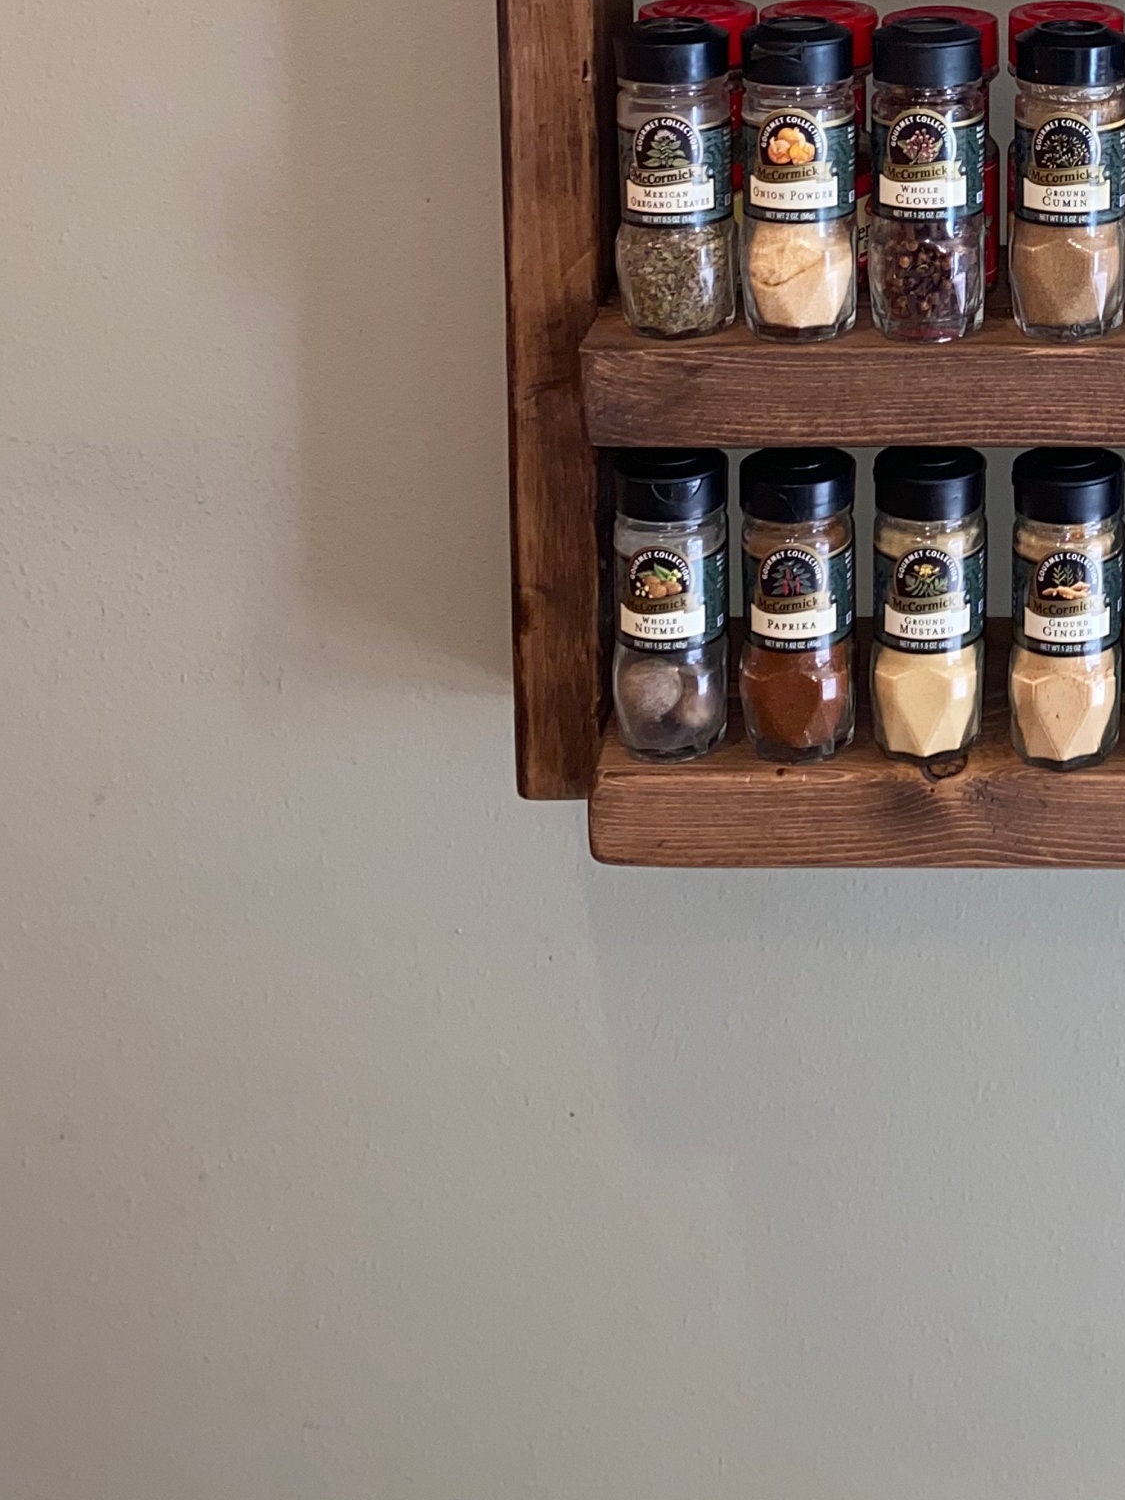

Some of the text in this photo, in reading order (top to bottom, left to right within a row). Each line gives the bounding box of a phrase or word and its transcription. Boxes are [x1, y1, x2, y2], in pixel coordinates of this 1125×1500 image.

[636, 119, 698, 151] GOURMET COLLECTION
[761, 115, 822, 148] GOURMET COLLECTION
[890, 116, 914, 147] GOURMET
[1035, 119, 1059, 150] GOURMET
[633, 169, 694, 184] McCormick
[757, 166, 819, 181] McCormick
[887, 165, 948, 180] McCormick
[1031, 170, 1091, 183] McCormick
[643, 189, 688, 198] MEXICAN
[753, 186, 833, 200] ONION POWDER
[900, 184, 939, 194] WHOLE
[1045, 187, 1086, 197] GROUND
[631, 197, 672, 208] OREGANO
[895, 193, 945, 205] CLOVES
[1042, 195, 1087, 207] CUMIN
[630, 551, 652, 580] GOURMET
[654, 550, 690, 581] COLLECTION
[762, 550, 785, 580] GOURMET
[787, 549, 822, 580] COLLECTION
[898, 550, 923, 578] GOURMET
[925, 549, 958, 582] COLLECTION
[1038, 553, 1064, 582] GOURMET
[759, 596, 818, 612] McCormick
[892, 596, 956, 613] McCormick
[1034, 600, 1096, 615] McCormick
[641, 615, 678, 625] WHOLE
[767, 618, 817, 630] PAPRIKA
[904, 616, 946, 625] GROUND
[1048, 619, 1088, 627] GROUND
[634, 623, 684, 635] NUTMEG
[899, 624, 954, 635] MUSTARD
[1042, 626, 1093, 637] GINGER
